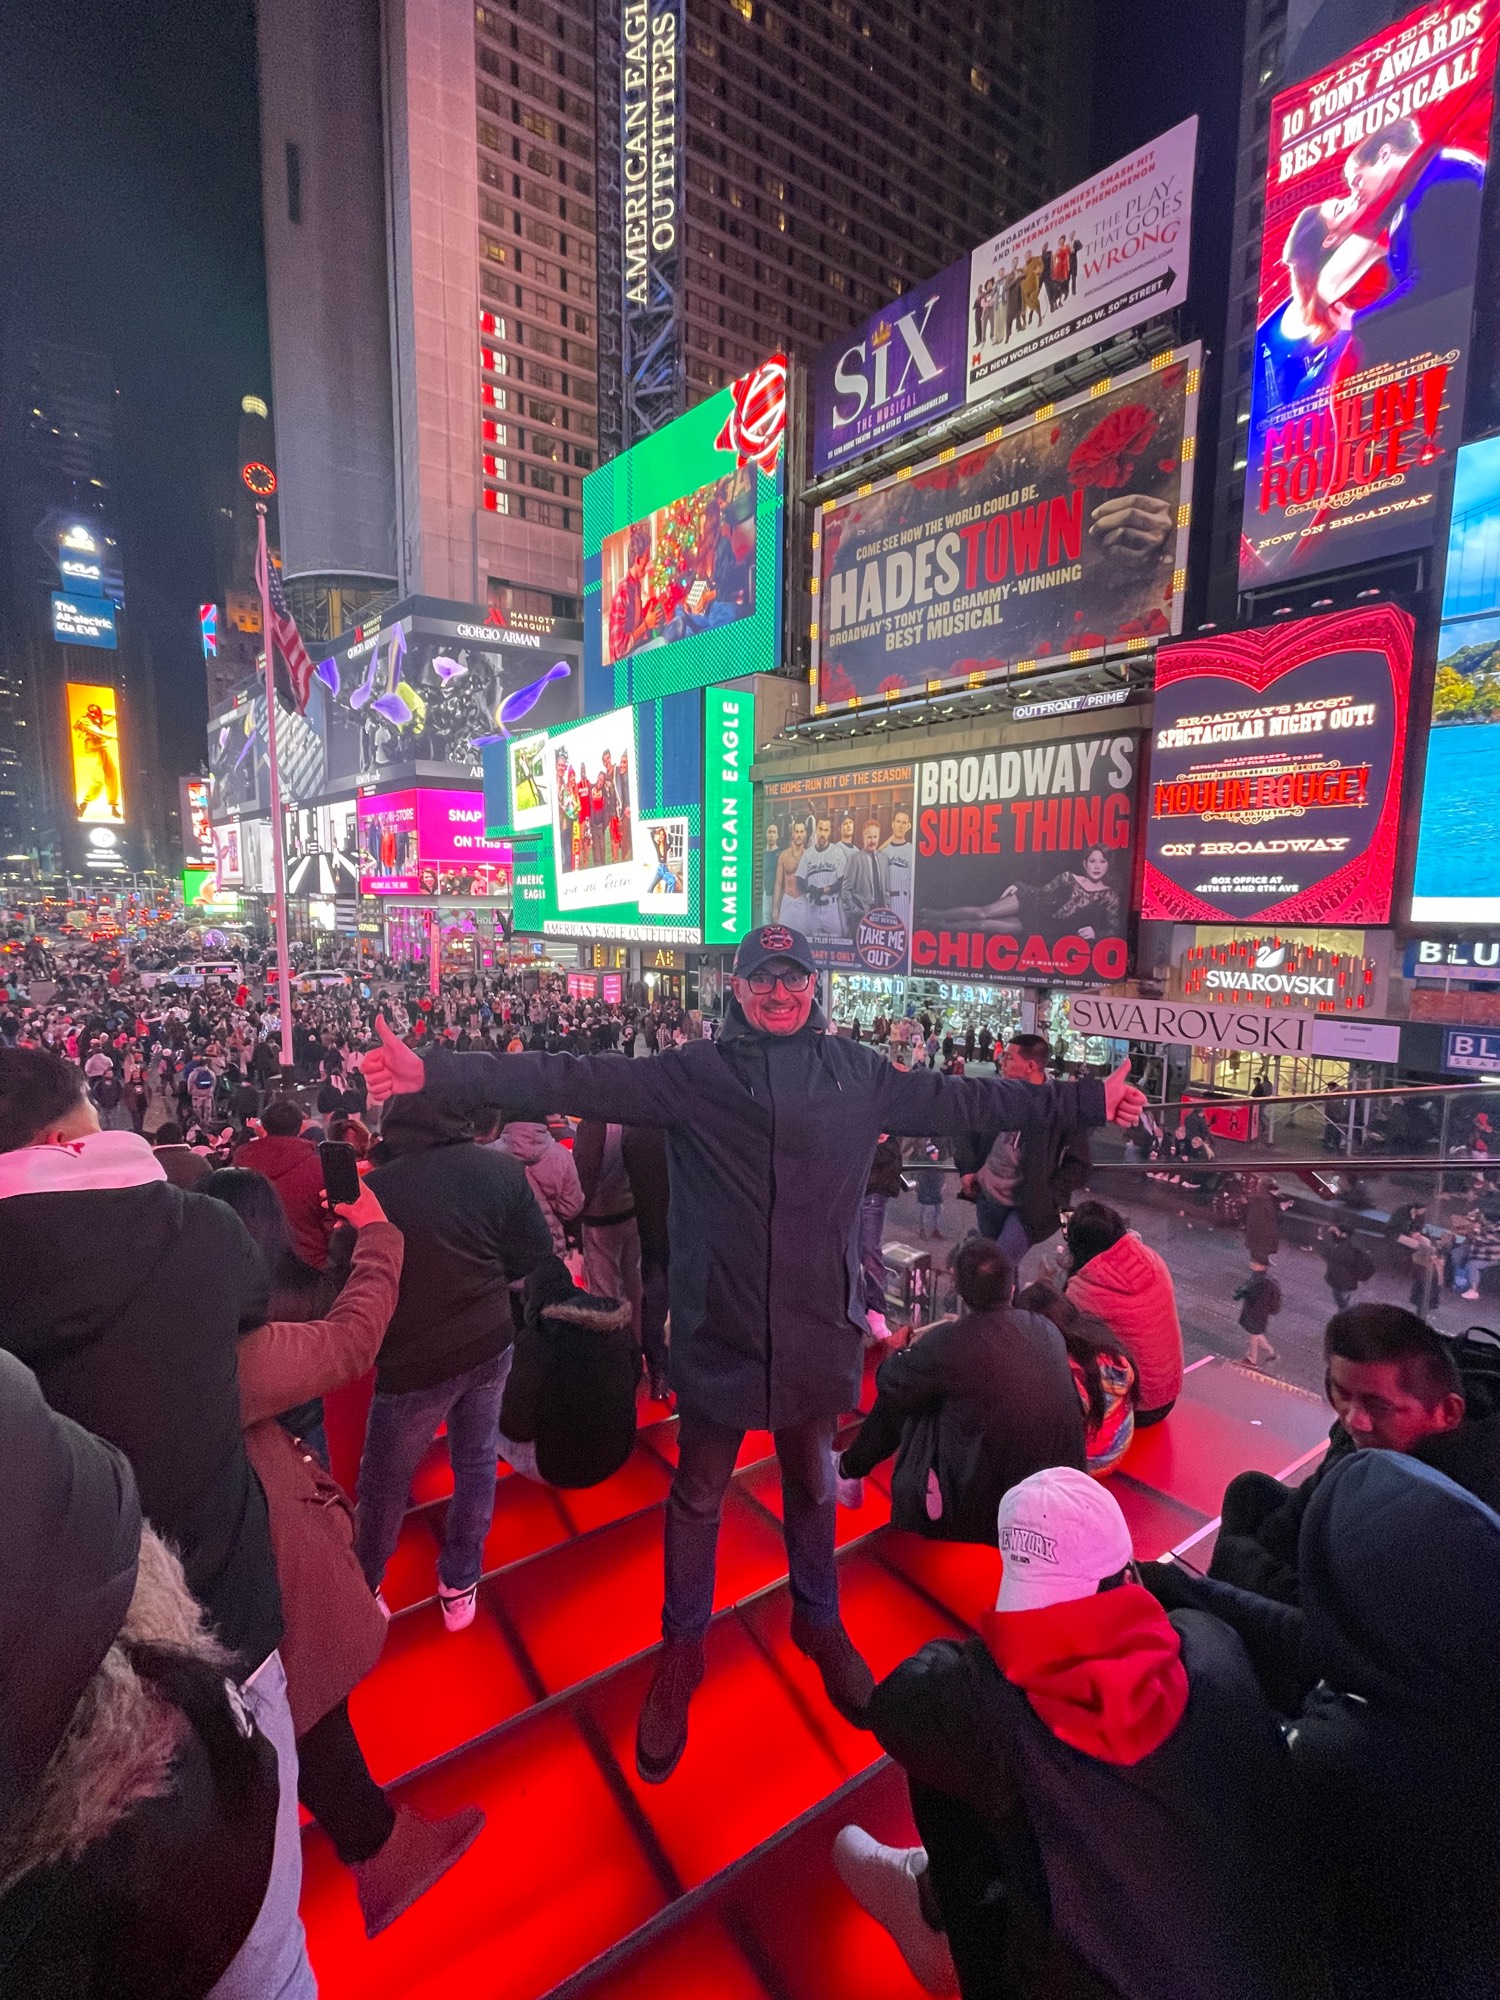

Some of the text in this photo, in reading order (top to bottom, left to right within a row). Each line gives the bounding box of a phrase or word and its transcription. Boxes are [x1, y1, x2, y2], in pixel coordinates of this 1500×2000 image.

[1281, 0, 1487, 144] 10 TONY AWARDS
[1278, 46, 1480, 184] BEST MUSICAL!
[652, 12, 675, 250] OUTFITTERS
[625, 0, 648, 304] AMERICAN EAGL
[992, 162, 1156, 264] AND INTERNATIONAL PHENOMENON
[994, 150, 1155, 252] BROADWAY'S FUNNIEST SMASH HIT
[1093, 174, 1176, 236] THE PLAY
[1084, 191, 1183, 257] THAT GOES
[1082, 221, 1181, 279] WRONG
[990, 355, 1008, 371] NEW
[1009, 342, 1038, 363] WORLD
[1039, 327, 1071, 350] STAGES
[1075, 314, 1093, 329] 340
[1128, 280, 1163, 303] STREET
[833, 296, 943, 430] SIX
[857, 392, 917, 433] THE MUSICAL
[856, 483, 1039, 561] COME SEE HOW THE WORLD COULD BE.
[1258, 494, 1433, 550] NOW ON BROADWAY
[829, 488, 1084, 631] HADESTOWN
[55, 601, 77, 613] The
[56, 612, 113, 630] All-electric
[510, 611, 556, 625] MARRIOTT
[56, 622, 75, 633] Kia
[363, 625, 380, 637] MARQUIS
[457, 624, 540, 647] GIORGIO ARMANI
[510, 621, 551, 633] MARQUIS
[829, 619, 893, 647] BROADWAY'S
[926, 599, 950, 618] AND
[885, 604, 1003, 652] BEST MUSICAL
[1015, 690, 1124, 719] OUTFRONT PRIME
[1176, 695, 1353, 728] BROADWAY'S MOST
[1157, 704, 1375, 749] SPECTACULAR NIGHT OUT!
[470, 766, 484, 778] AR
[764, 767, 912, 796] THE HOME-RUN HIT OF THE SEASON!
[920, 736, 1134, 807] BROADWAY'S
[1154, 766, 1370, 815] MOULIN ROUGE!
[448, 809, 482, 822] SNAP
[721, 701, 739, 933] AMERICAN EAGLE
[919, 792, 1132, 858] SURE THING
[454, 836, 472, 847] ON
[1160, 838, 1351, 857] ON BROADWAY
[516, 874, 544, 886] AMERIC
[1211, 875, 1283, 885] BOX OFFICE AT
[1222, 885, 1236, 893] ST
[1237, 885, 1258, 893] AND
[1279, 884, 1299, 893] AVE
[545, 923, 699, 944] AMERICAN EAGLE OUTFITTERS
[859, 925, 905, 952] TAKE ME
[836, 952, 856, 962] ONLY
[867, 950, 891, 967] OUT
[912, 929, 1128, 980] CHICAGO
[1419, 941, 1500, 965] BLU
[851, 975, 904, 994] GRAND
[913, 968, 984, 979] CHICAGOTHEMUSICAL.COM
[1205, 970, 1335, 996] SWAROVSKI
[940, 983, 993, 1004] SLAM
[1072, 999, 1307, 1050] SWAROVSKI
[1454, 1036, 1497, 1058] BL
[1454, 1058, 1500, 1068] SEAF
